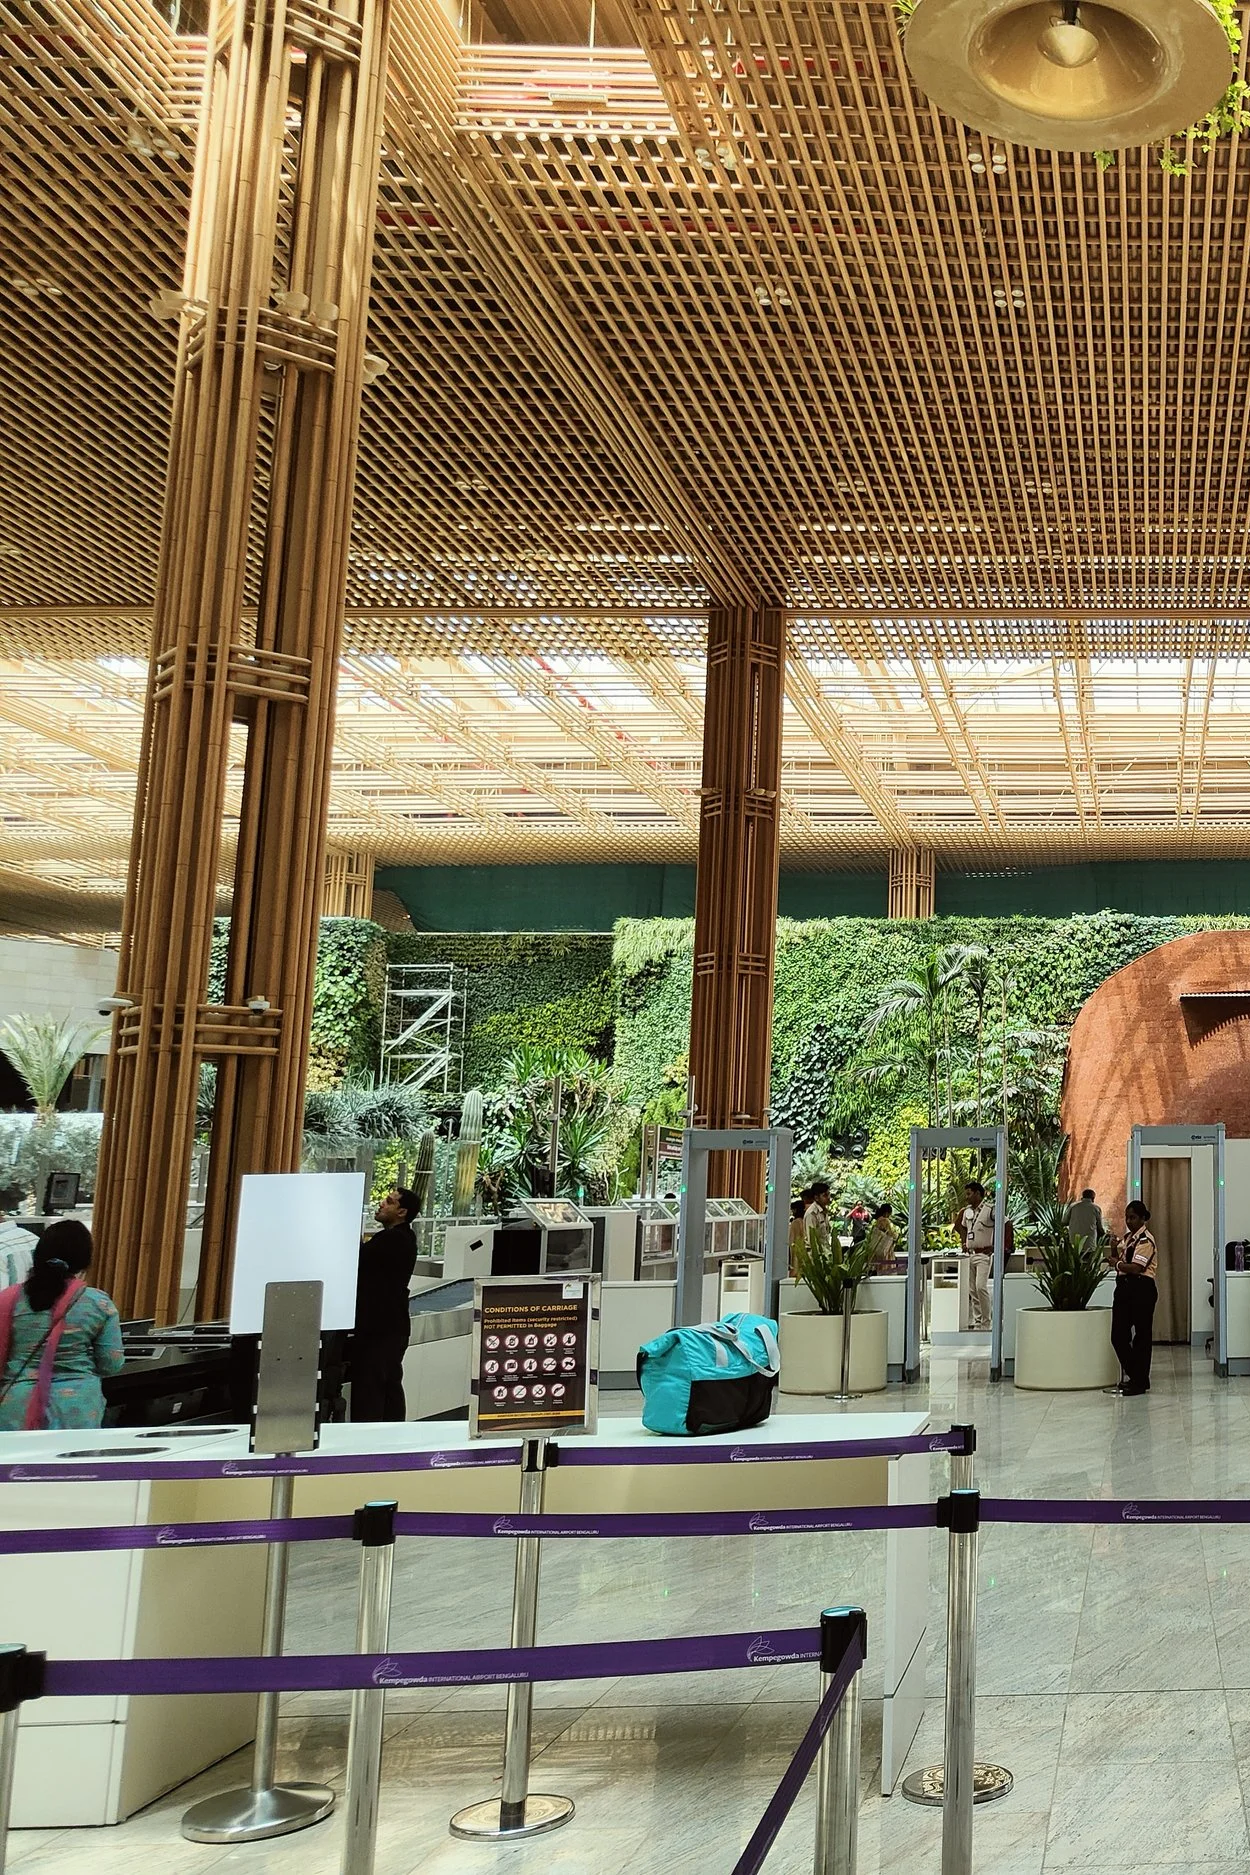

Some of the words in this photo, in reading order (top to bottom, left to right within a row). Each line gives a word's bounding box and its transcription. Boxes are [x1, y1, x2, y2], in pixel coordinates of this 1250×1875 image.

[484, 1306, 529, 1314] CONDITIONS
[541, 1304, 578, 1312] CARRIAGE
[753, 1653, 800, 1663] Kempegowda
[379, 1676, 428, 1686] Kempegowda
